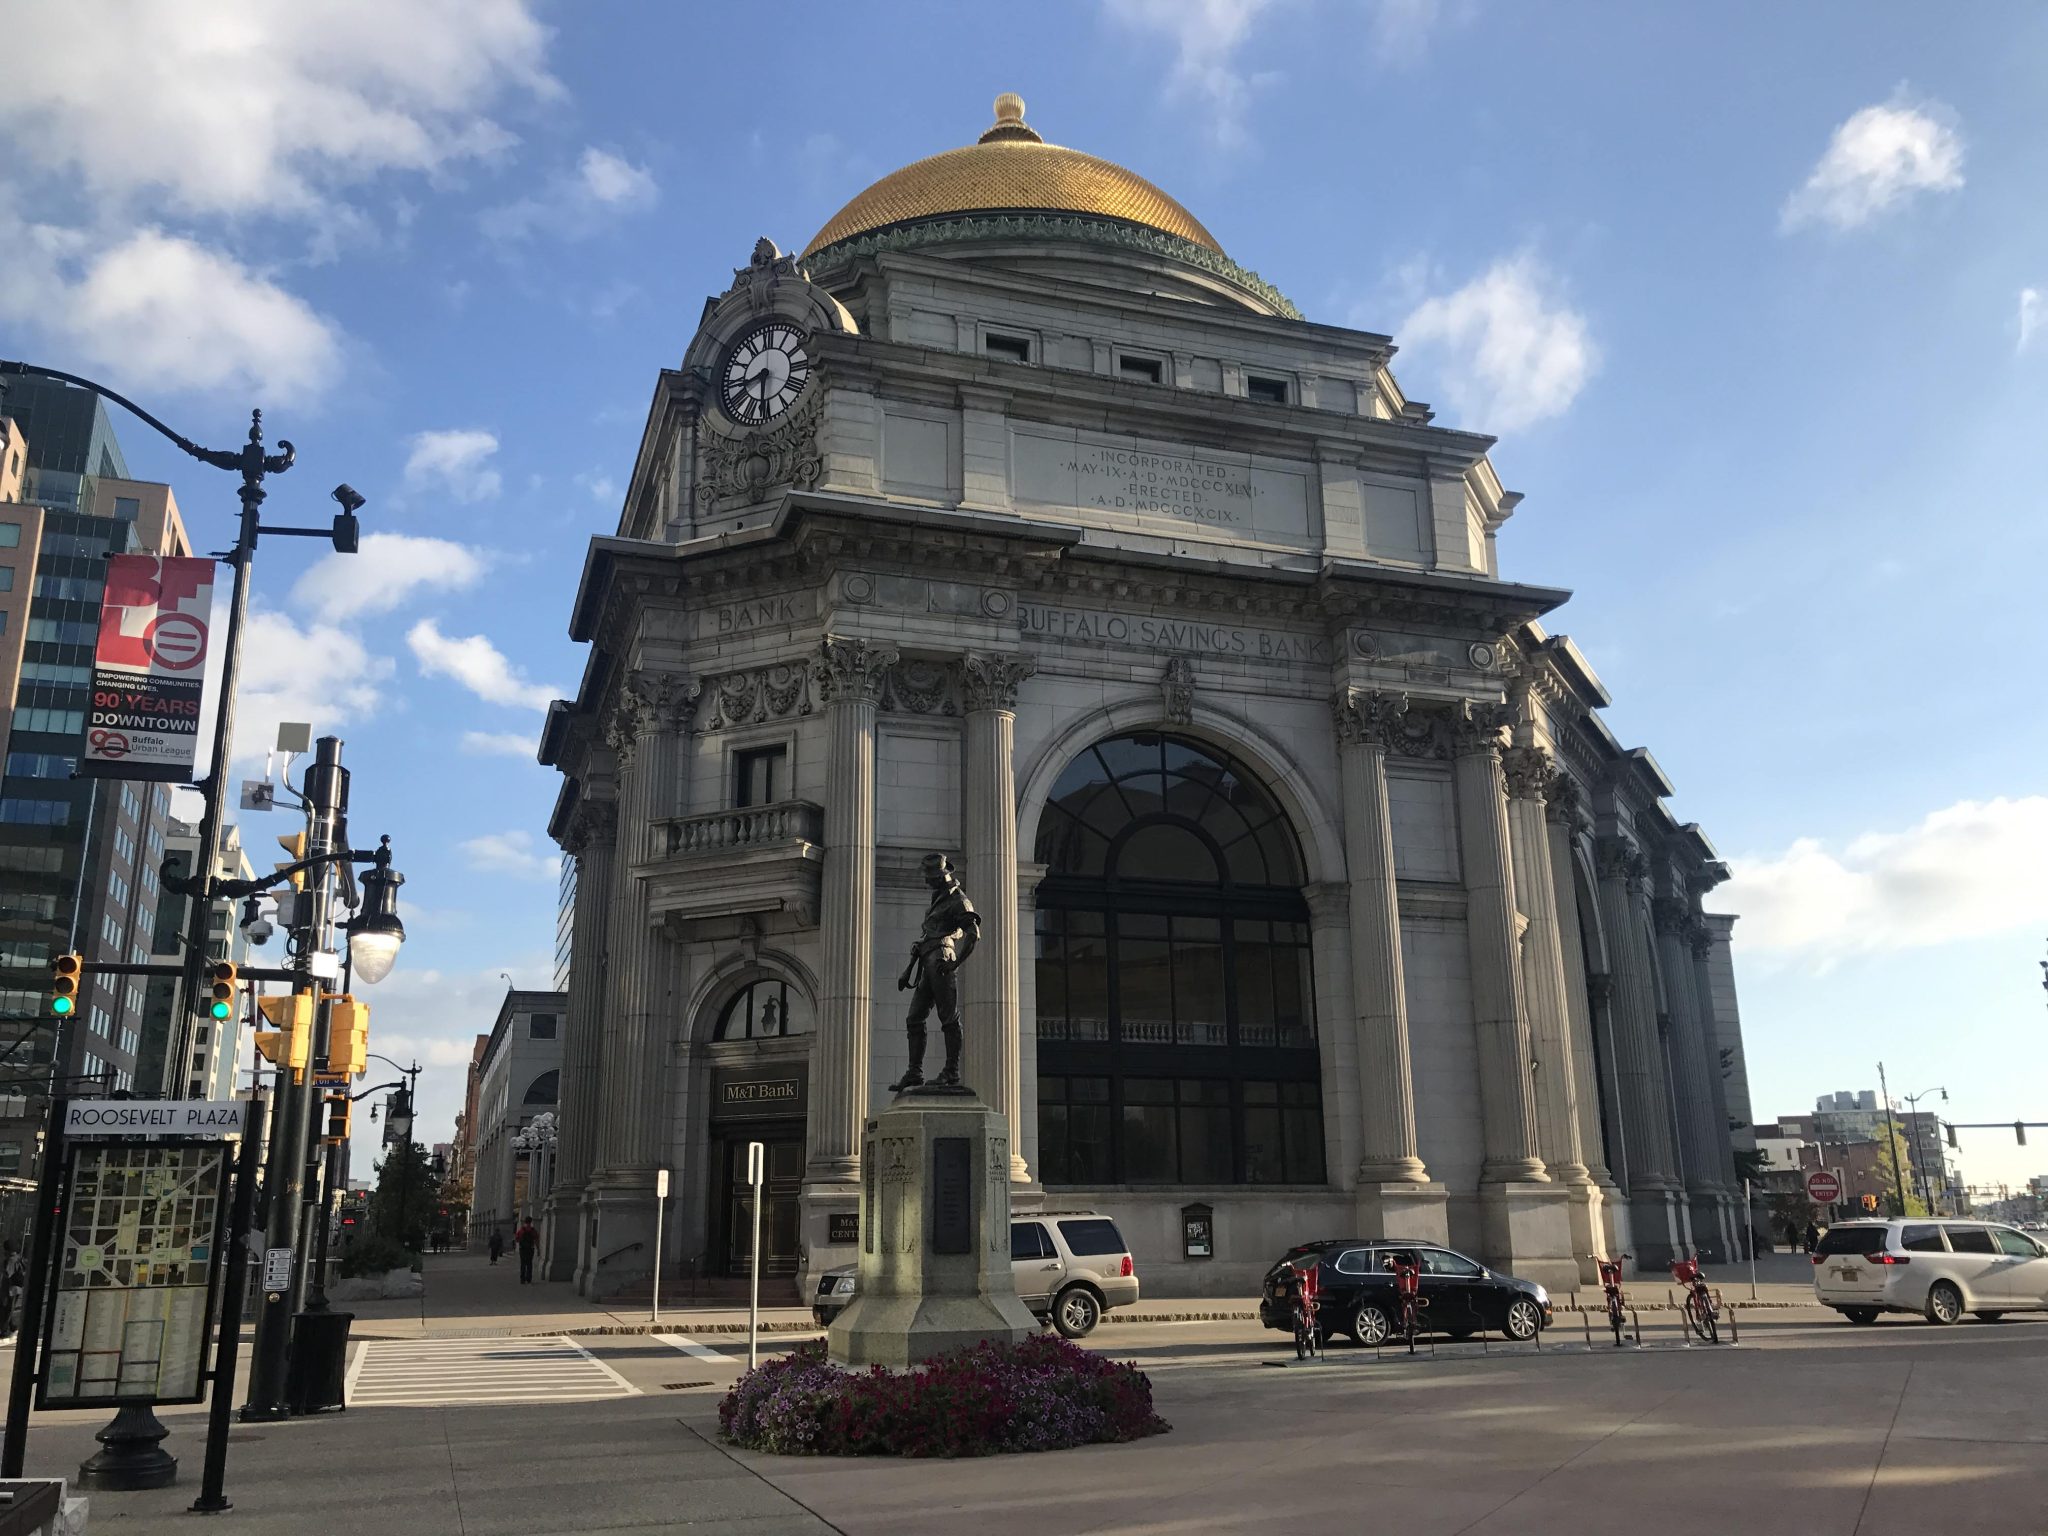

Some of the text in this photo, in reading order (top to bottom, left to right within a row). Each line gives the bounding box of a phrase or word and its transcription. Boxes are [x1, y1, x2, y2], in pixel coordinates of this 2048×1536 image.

[1101, 451, 1227, 478] INCORPORATED
[1129, 483, 1202, 503] ERECTED
[718, 596, 795, 632] BANK
[1016, 606, 1324, 662] BUFFALO SAVINGS BANK
[96, 680, 136, 690] CHANGING
[97, 672, 148, 683] EMPOWERING
[94, 691, 199, 715] 90 YEARS
[92, 712, 196, 732] DOWNTOWN
[132, 736, 164, 745] Buffalo
[131, 744, 158, 753] Urban
[161, 745, 191, 756] League
[728, 1083, 794, 1099] M&T Bank
[69, 1109, 239, 1125] ROOSEVELT PLAZA
